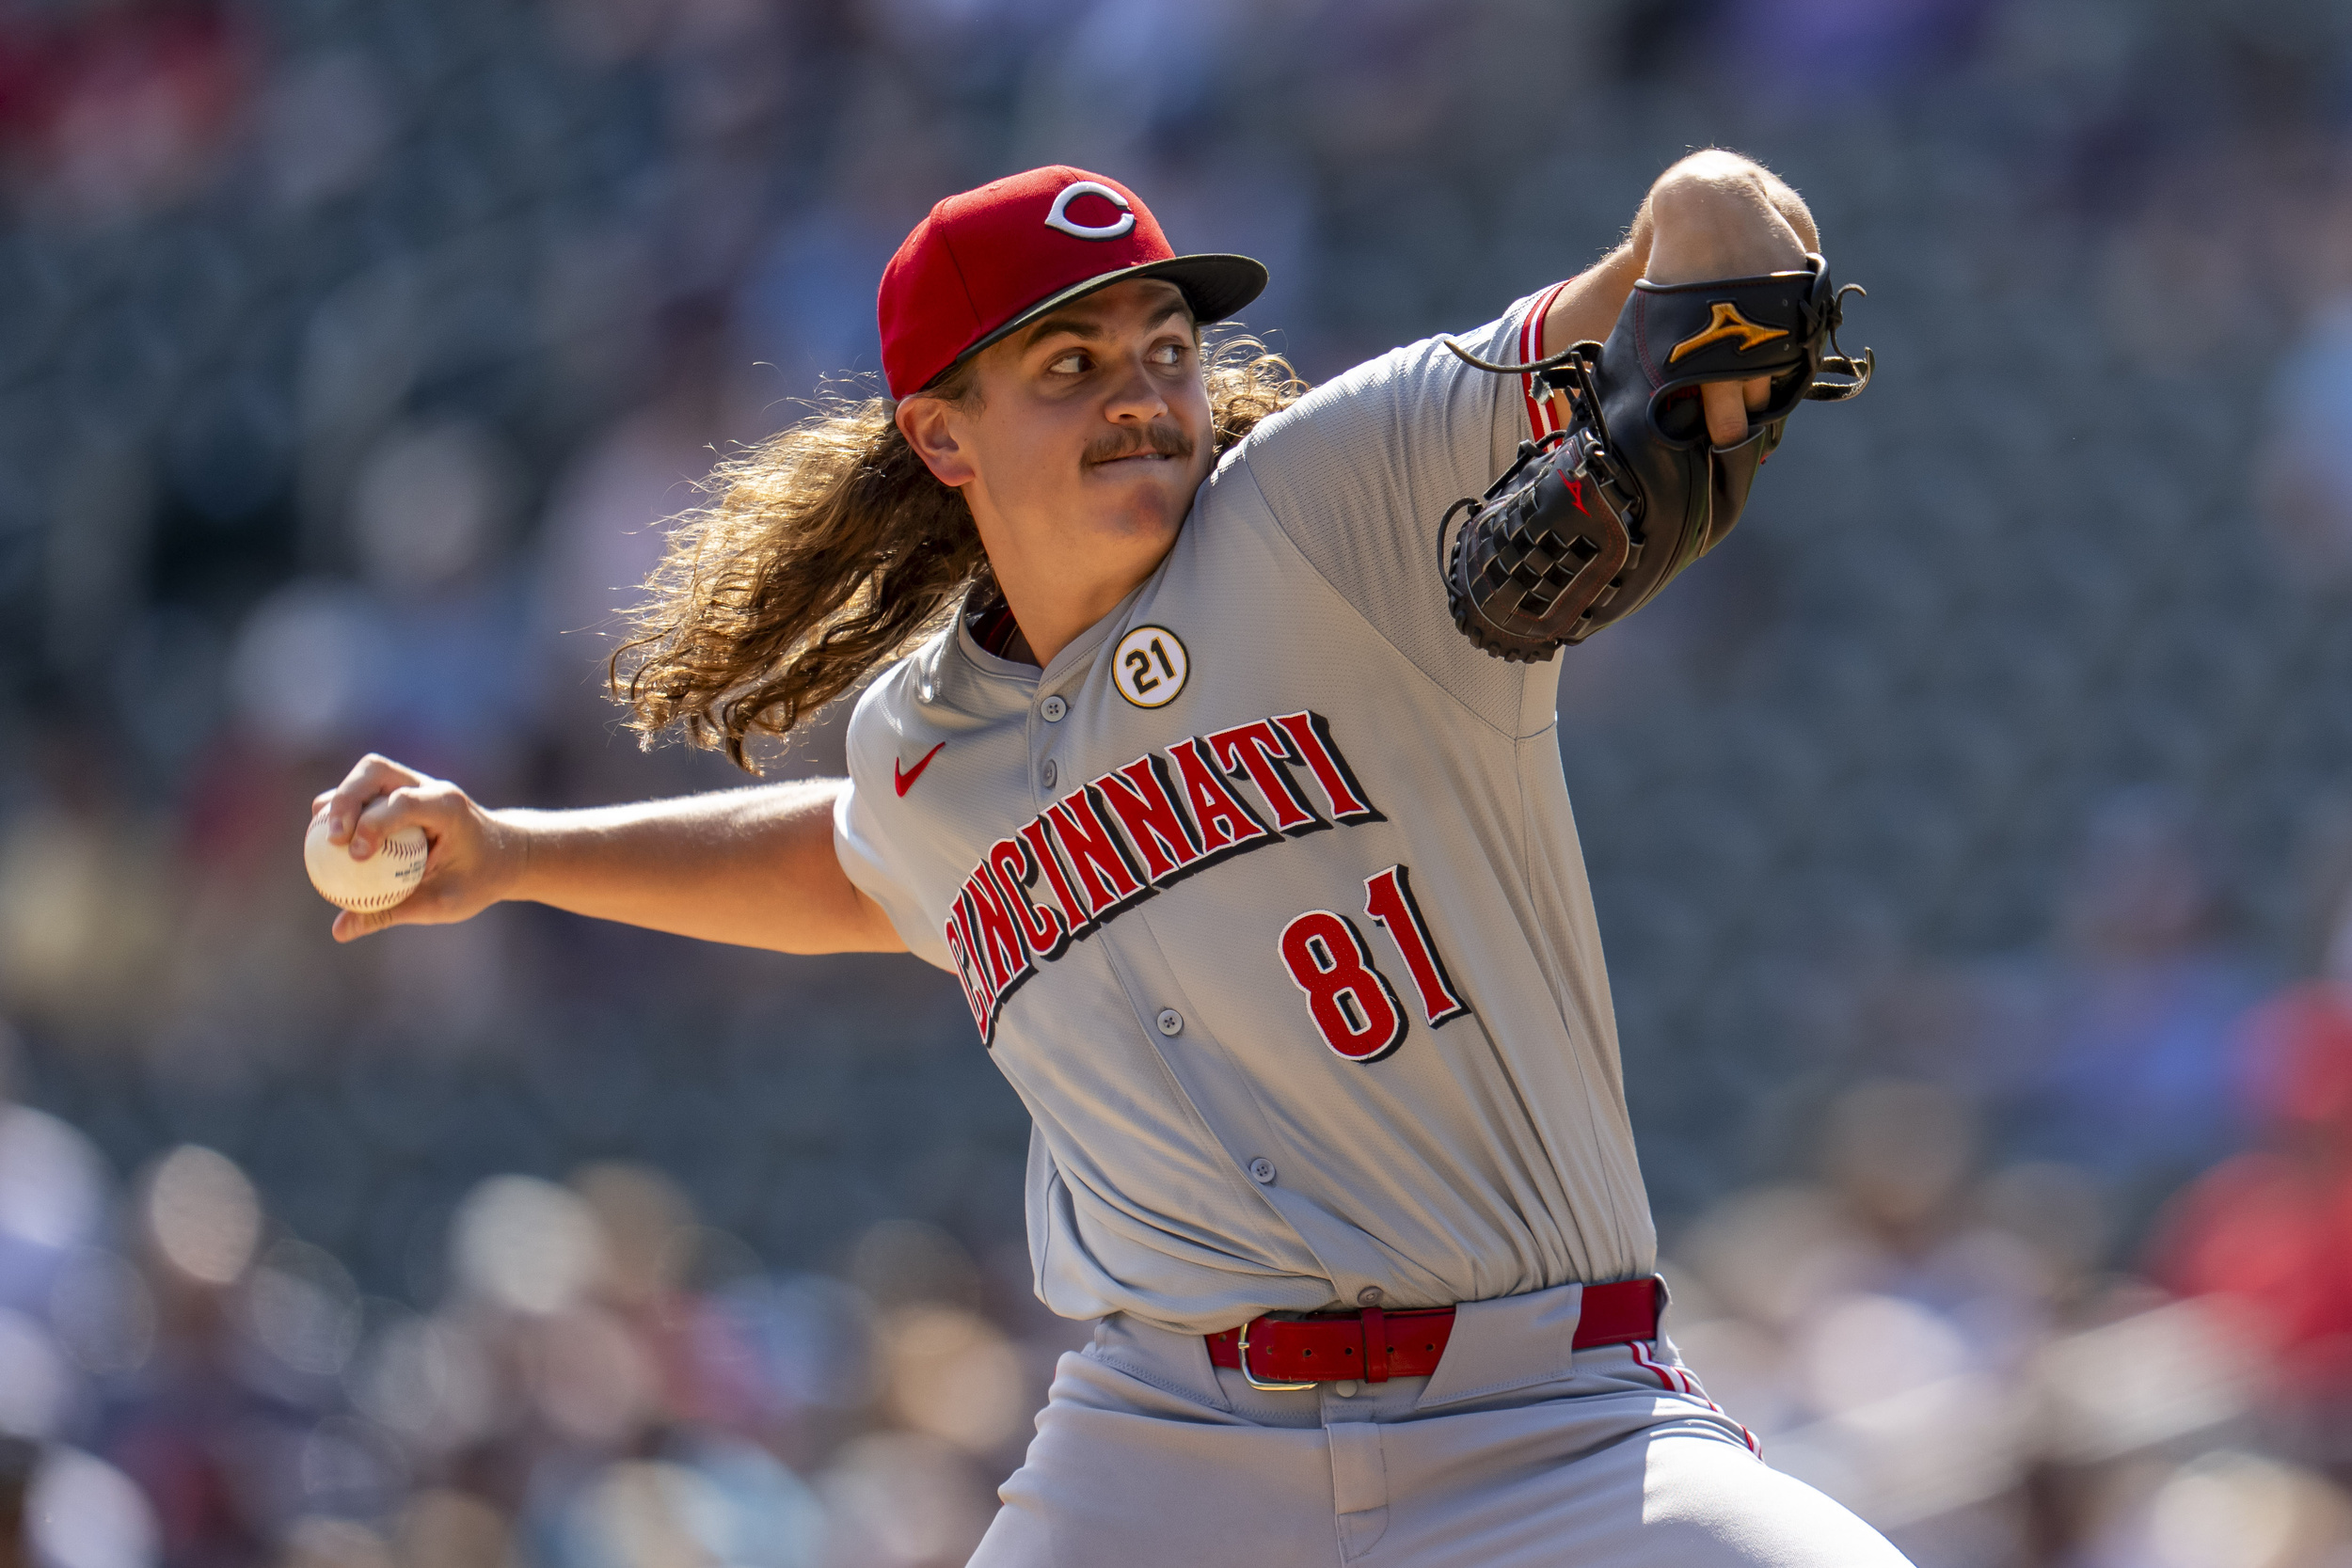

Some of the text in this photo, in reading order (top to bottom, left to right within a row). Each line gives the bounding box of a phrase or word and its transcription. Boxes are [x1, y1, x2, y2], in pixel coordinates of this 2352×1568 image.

[1044, 180, 1136, 242] C
[1125, 636, 1177, 696] 21
[945, 709, 1385, 1047] CINCINNATI
[1278, 863, 1471, 1065] 81
